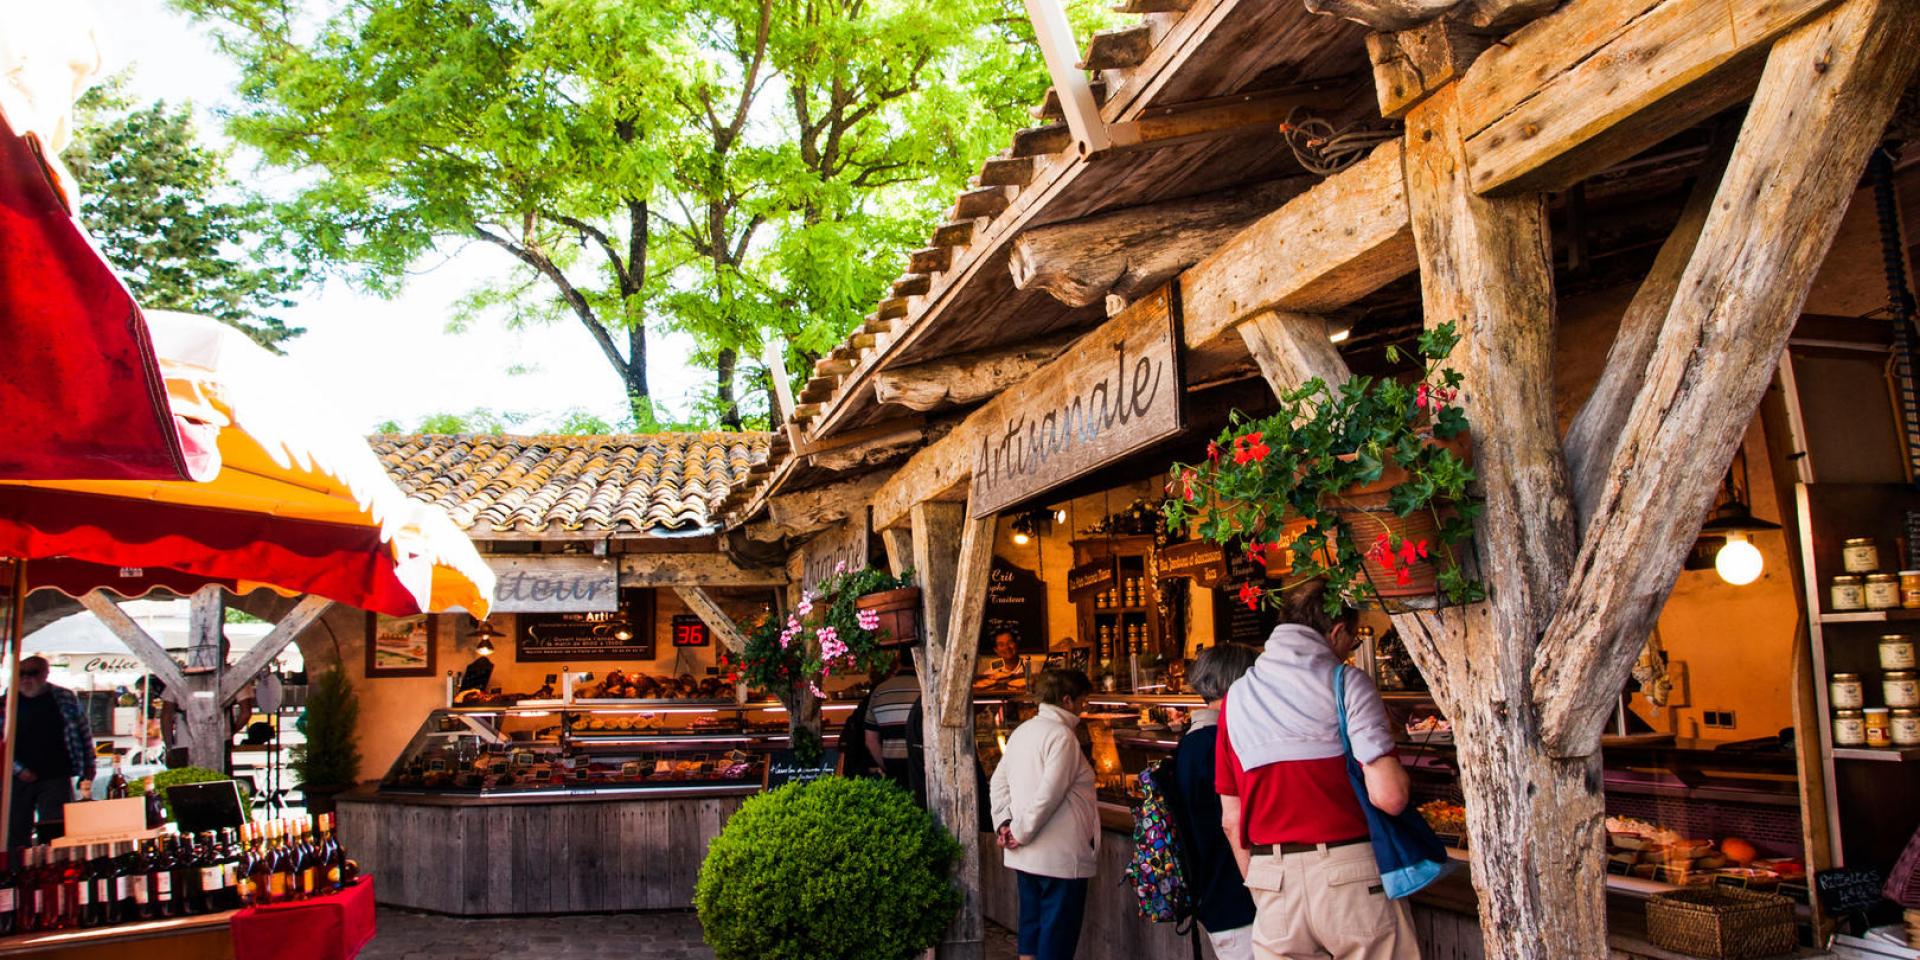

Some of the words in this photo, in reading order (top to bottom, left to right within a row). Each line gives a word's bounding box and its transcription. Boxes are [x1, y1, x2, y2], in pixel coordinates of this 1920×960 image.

[975, 340, 1162, 496] Artisanale
[494, 571, 612, 602] iteur
[677, 624, 703, 645] 36
[84, 657, 138, 672] Coffee
